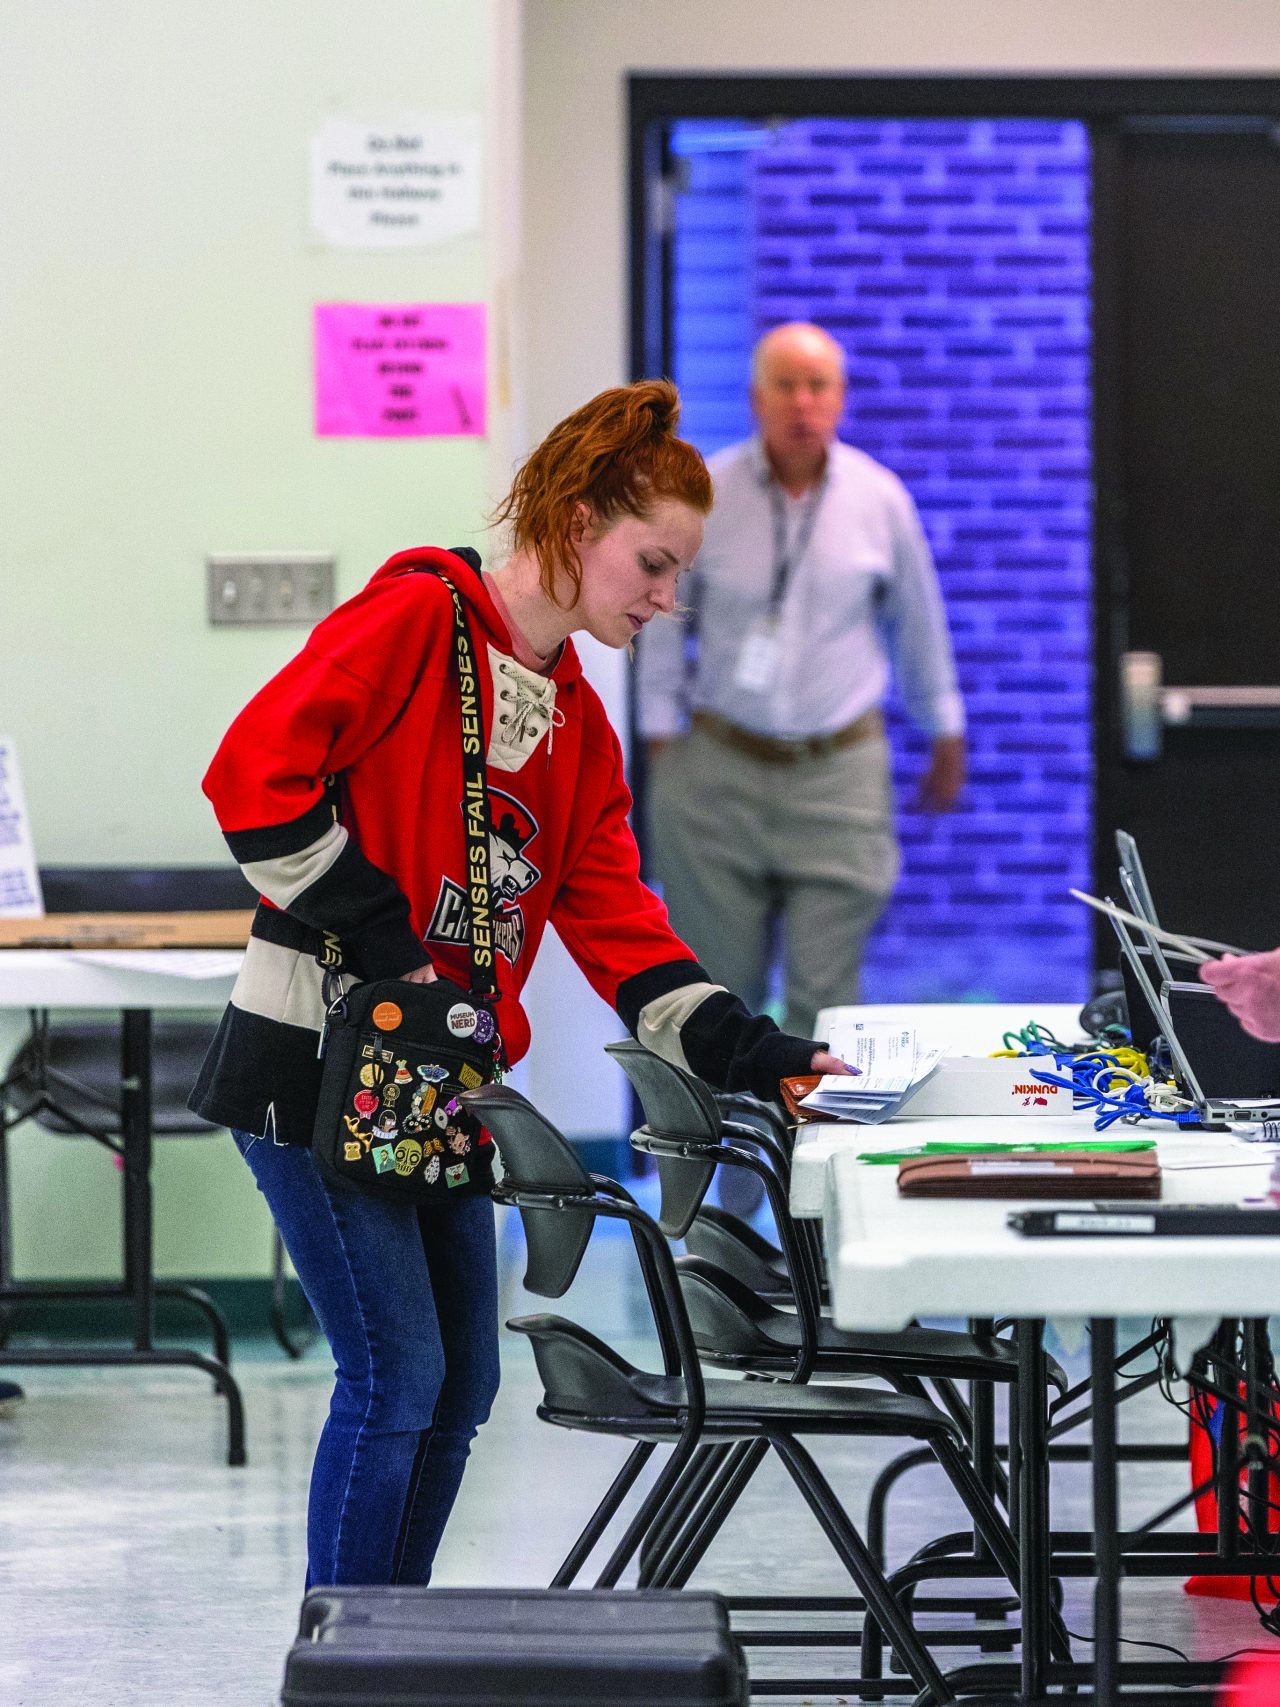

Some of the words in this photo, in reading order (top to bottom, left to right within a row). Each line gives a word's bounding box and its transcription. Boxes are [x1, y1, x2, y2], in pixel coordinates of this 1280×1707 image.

[458, 635, 481, 755] SENSES
[466, 772, 486, 837] FAIL
[470, 845, 492, 967] SENSES
[450, 1012, 475, 1020] MUSEUM
[451, 1018, 476, 1030] NERD
[1012, 1084, 1058, 1095] DUNKIN'
